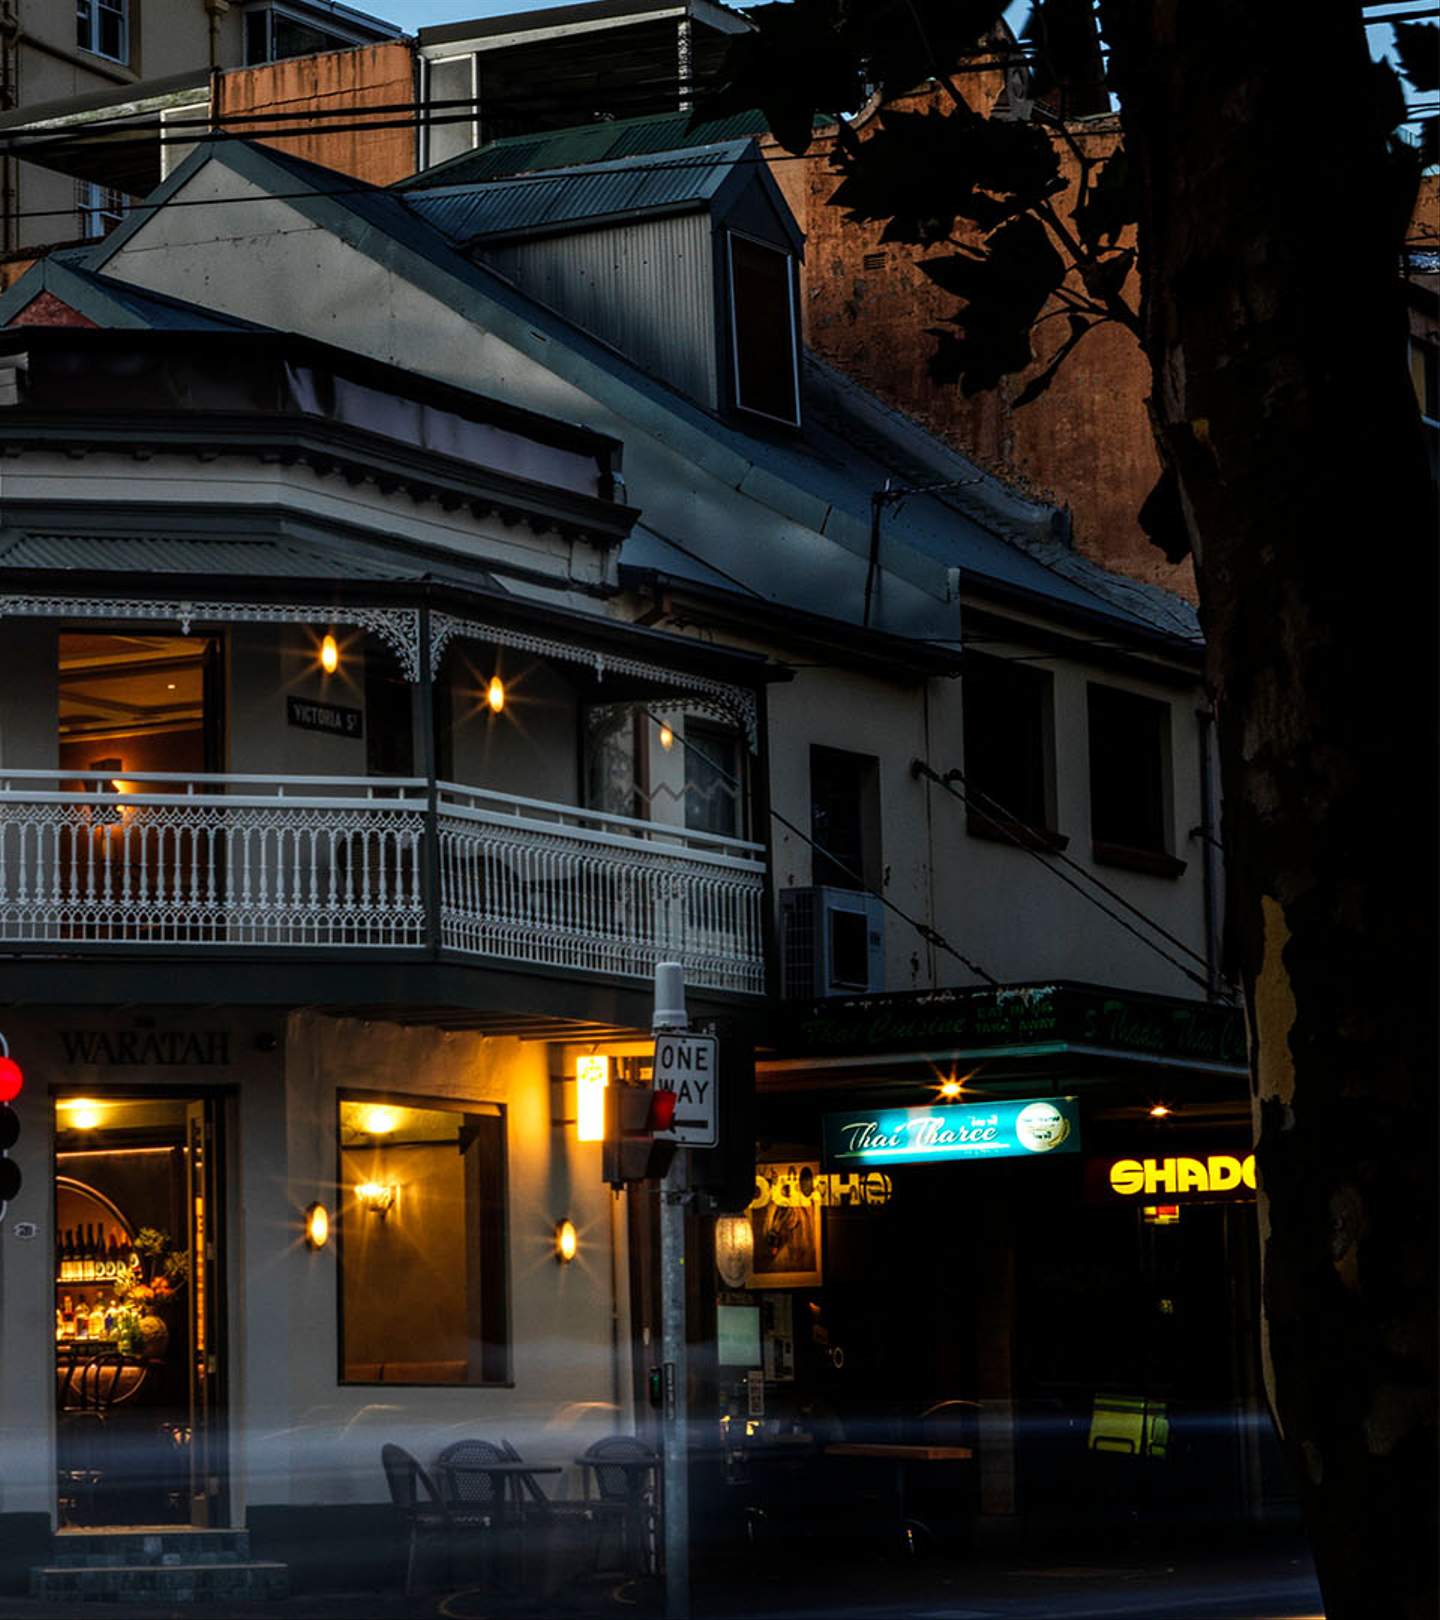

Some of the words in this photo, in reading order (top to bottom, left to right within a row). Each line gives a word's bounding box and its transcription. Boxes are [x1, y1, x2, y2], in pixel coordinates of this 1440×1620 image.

[292, 703, 342, 729] VICTORIA
[59, 1031, 229, 1065] WARATAH
[661, 1045, 708, 1071] ONE
[841, 1121, 901, 1151] Thai
